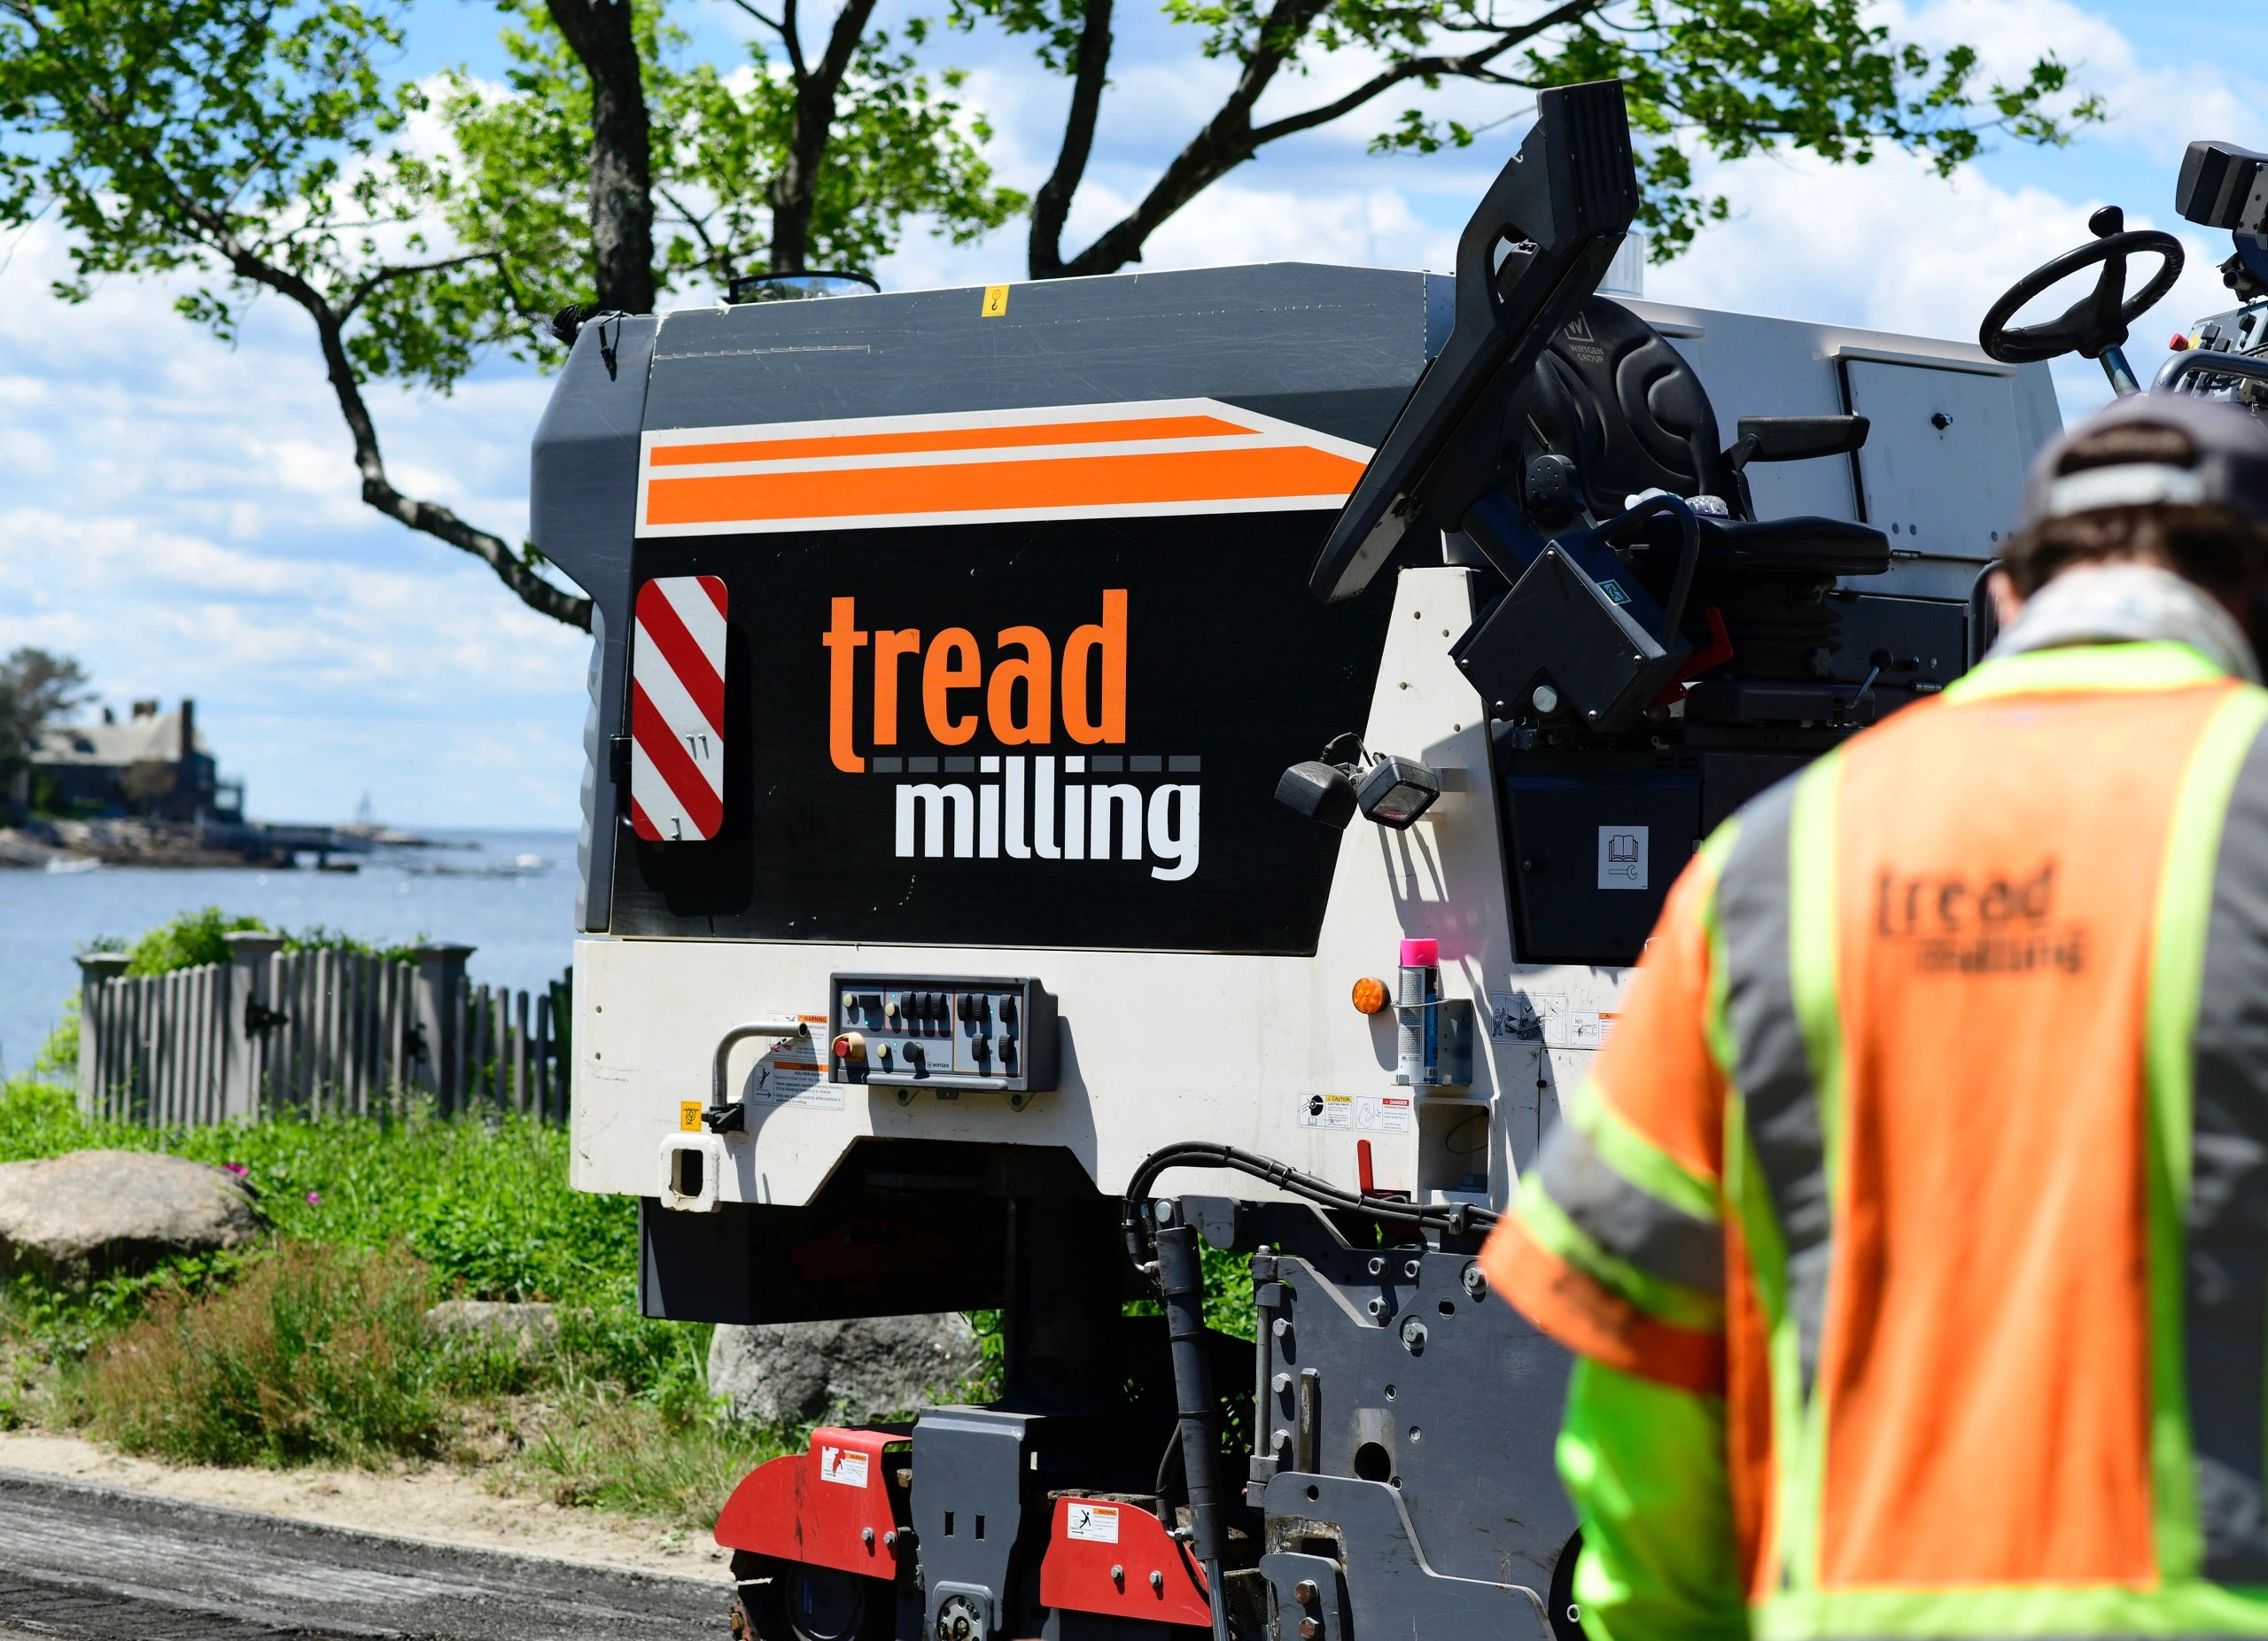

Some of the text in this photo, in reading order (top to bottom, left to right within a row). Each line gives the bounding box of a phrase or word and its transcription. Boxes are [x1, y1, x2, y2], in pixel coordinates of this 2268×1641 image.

[1568, 344, 1604, 354] WIRTGEN
[1577, 353, 1604, 363] GROUP
[822, 588, 1128, 774] tread
[895, 755, 1201, 882] milling
[1877, 862, 2054, 937] tread
